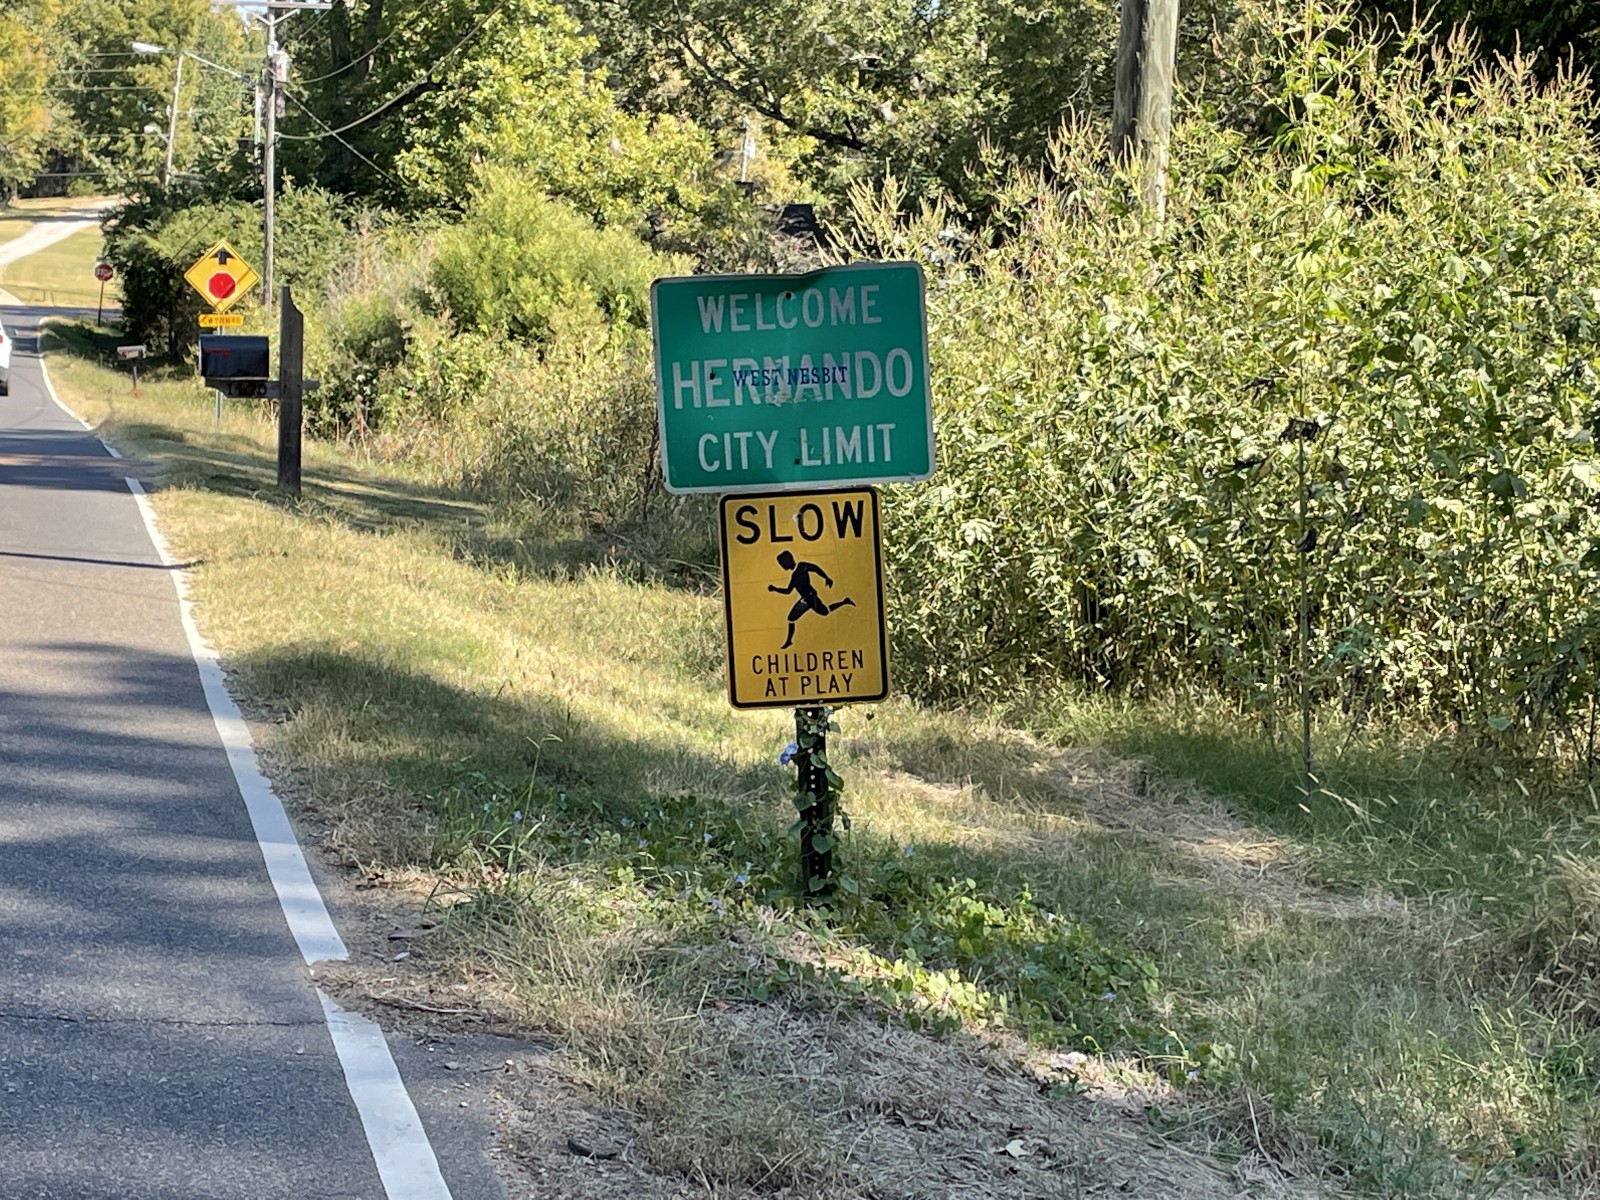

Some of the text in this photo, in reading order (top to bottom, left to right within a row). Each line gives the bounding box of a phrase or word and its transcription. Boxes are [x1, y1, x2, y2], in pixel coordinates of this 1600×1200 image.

[696, 284, 882, 334] WELCOME
[672, 347, 913, 410] HERNANDO
[733, 366, 848, 387] WEST NESBIT
[698, 423, 896, 472] CITY LIMIT
[735, 499, 865, 545] SLOW
[752, 649, 864, 675] CHILDREN
[765, 673, 854, 697] AT PLAY
